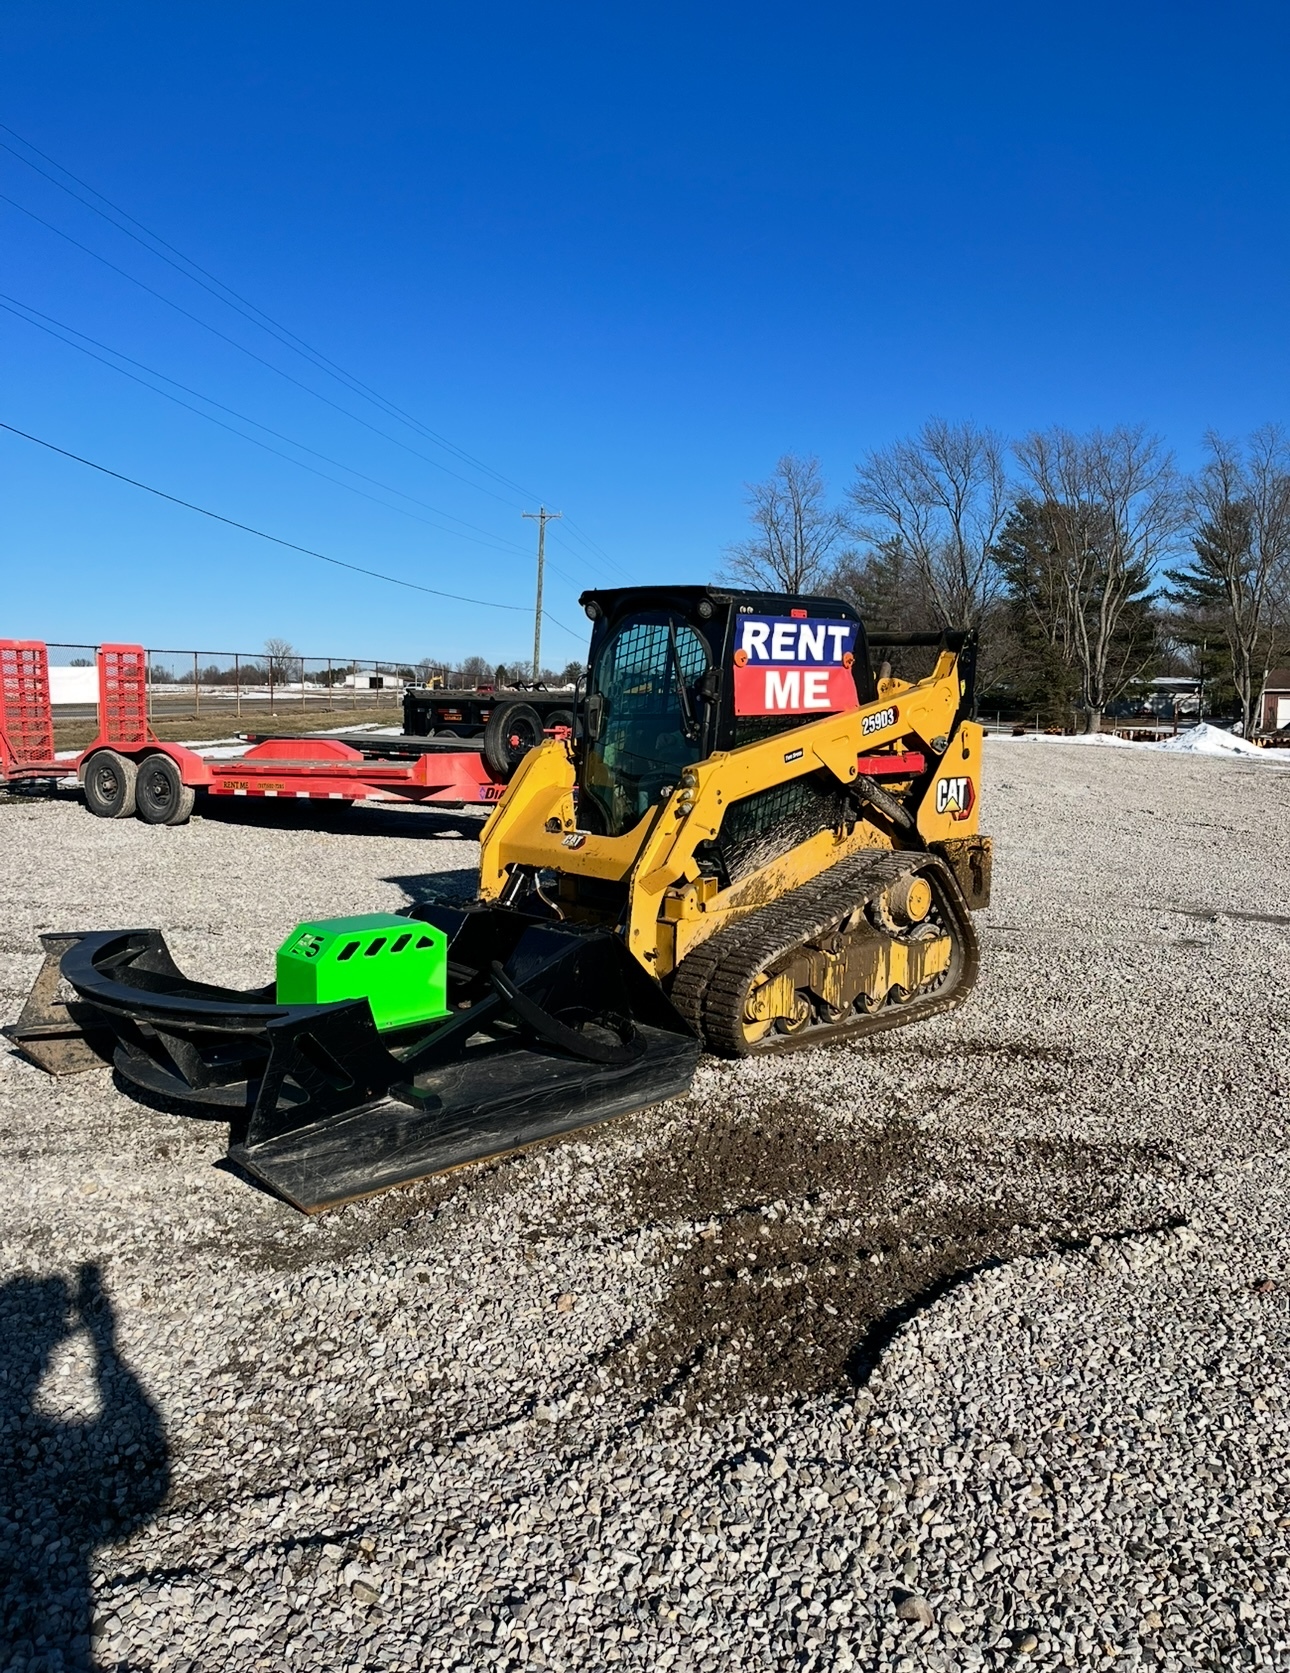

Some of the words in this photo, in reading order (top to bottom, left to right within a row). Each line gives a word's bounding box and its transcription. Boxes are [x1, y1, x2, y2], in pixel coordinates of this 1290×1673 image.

[741, 621, 850, 662] RENT
[765, 670, 832, 710] ME
[861, 707, 895, 735] 259D3
[239, 781, 249, 790] ME
[936, 778, 968, 813] CAT
[561, 834, 584, 847] CAT
